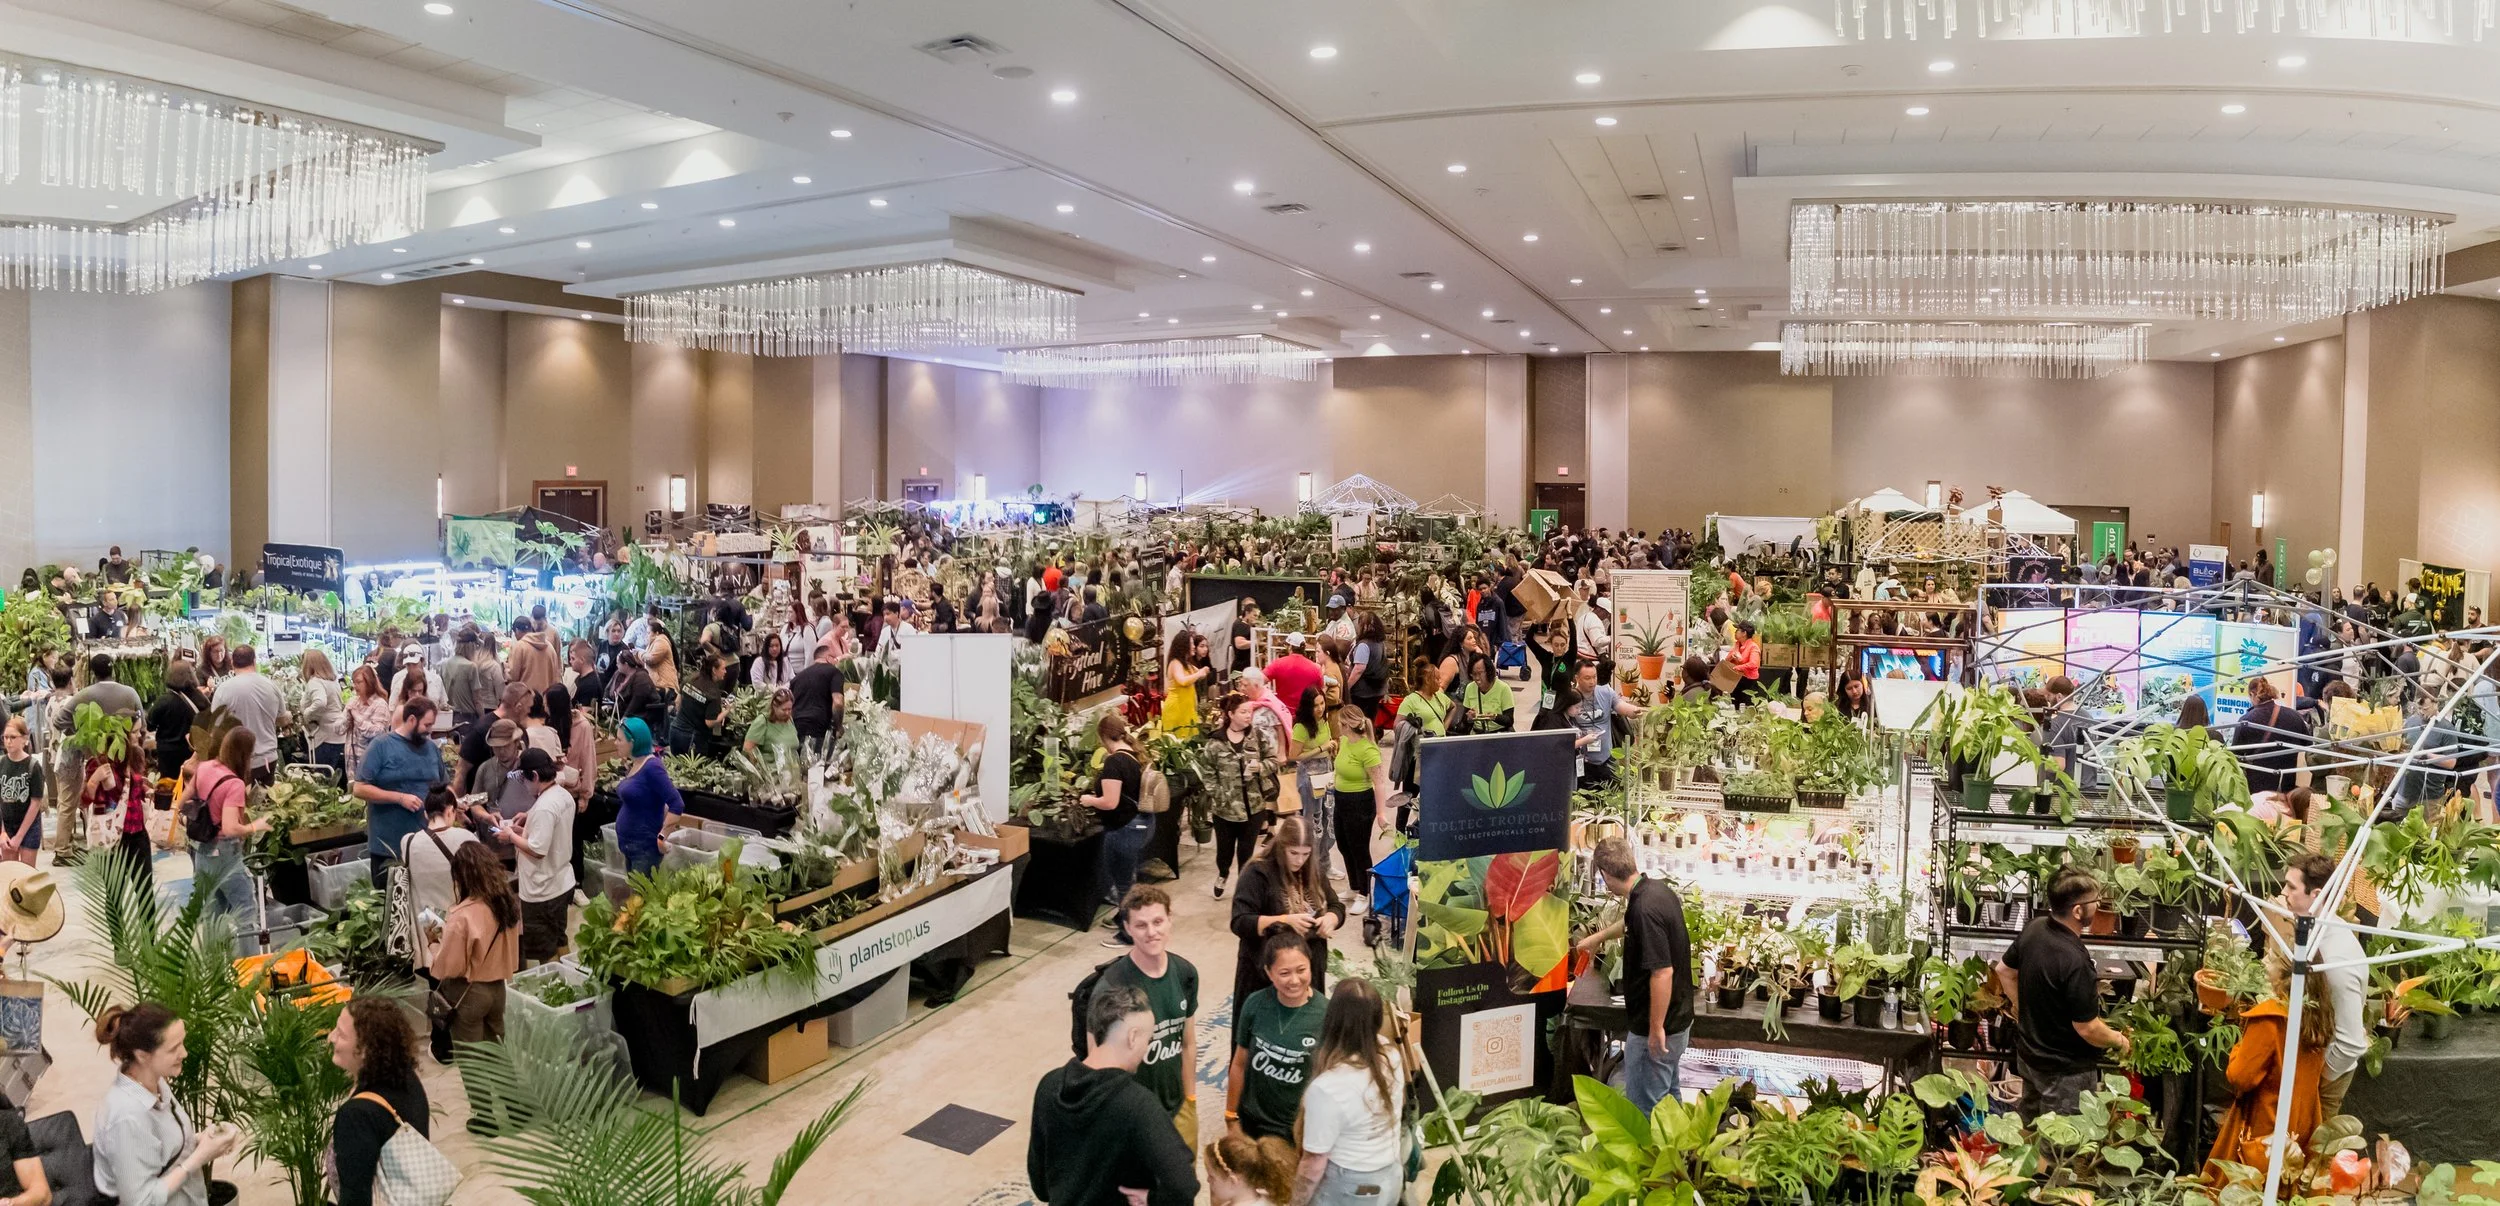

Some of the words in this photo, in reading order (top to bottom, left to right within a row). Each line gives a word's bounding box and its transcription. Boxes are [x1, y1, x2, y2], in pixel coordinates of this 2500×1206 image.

[2217, 706, 2232, 714] VIBE
[1428, 819, 1483, 833] TOLTEC
[1488, 810, 1565, 827] TROPICALS
[1454, 827, 1545, 841] TOLTECTROPICALS.COM
[849, 920, 931, 973] plantstop.us
[1437, 988, 1464, 998] Follow
[1466, 986, 1477, 994] Us
[1477, 983, 1489, 992] On
[1437, 992, 1482, 1006] Instagram!
[1143, 1037, 1183, 1065] Oasi
[1251, 1051, 1304, 1084] Oasis
